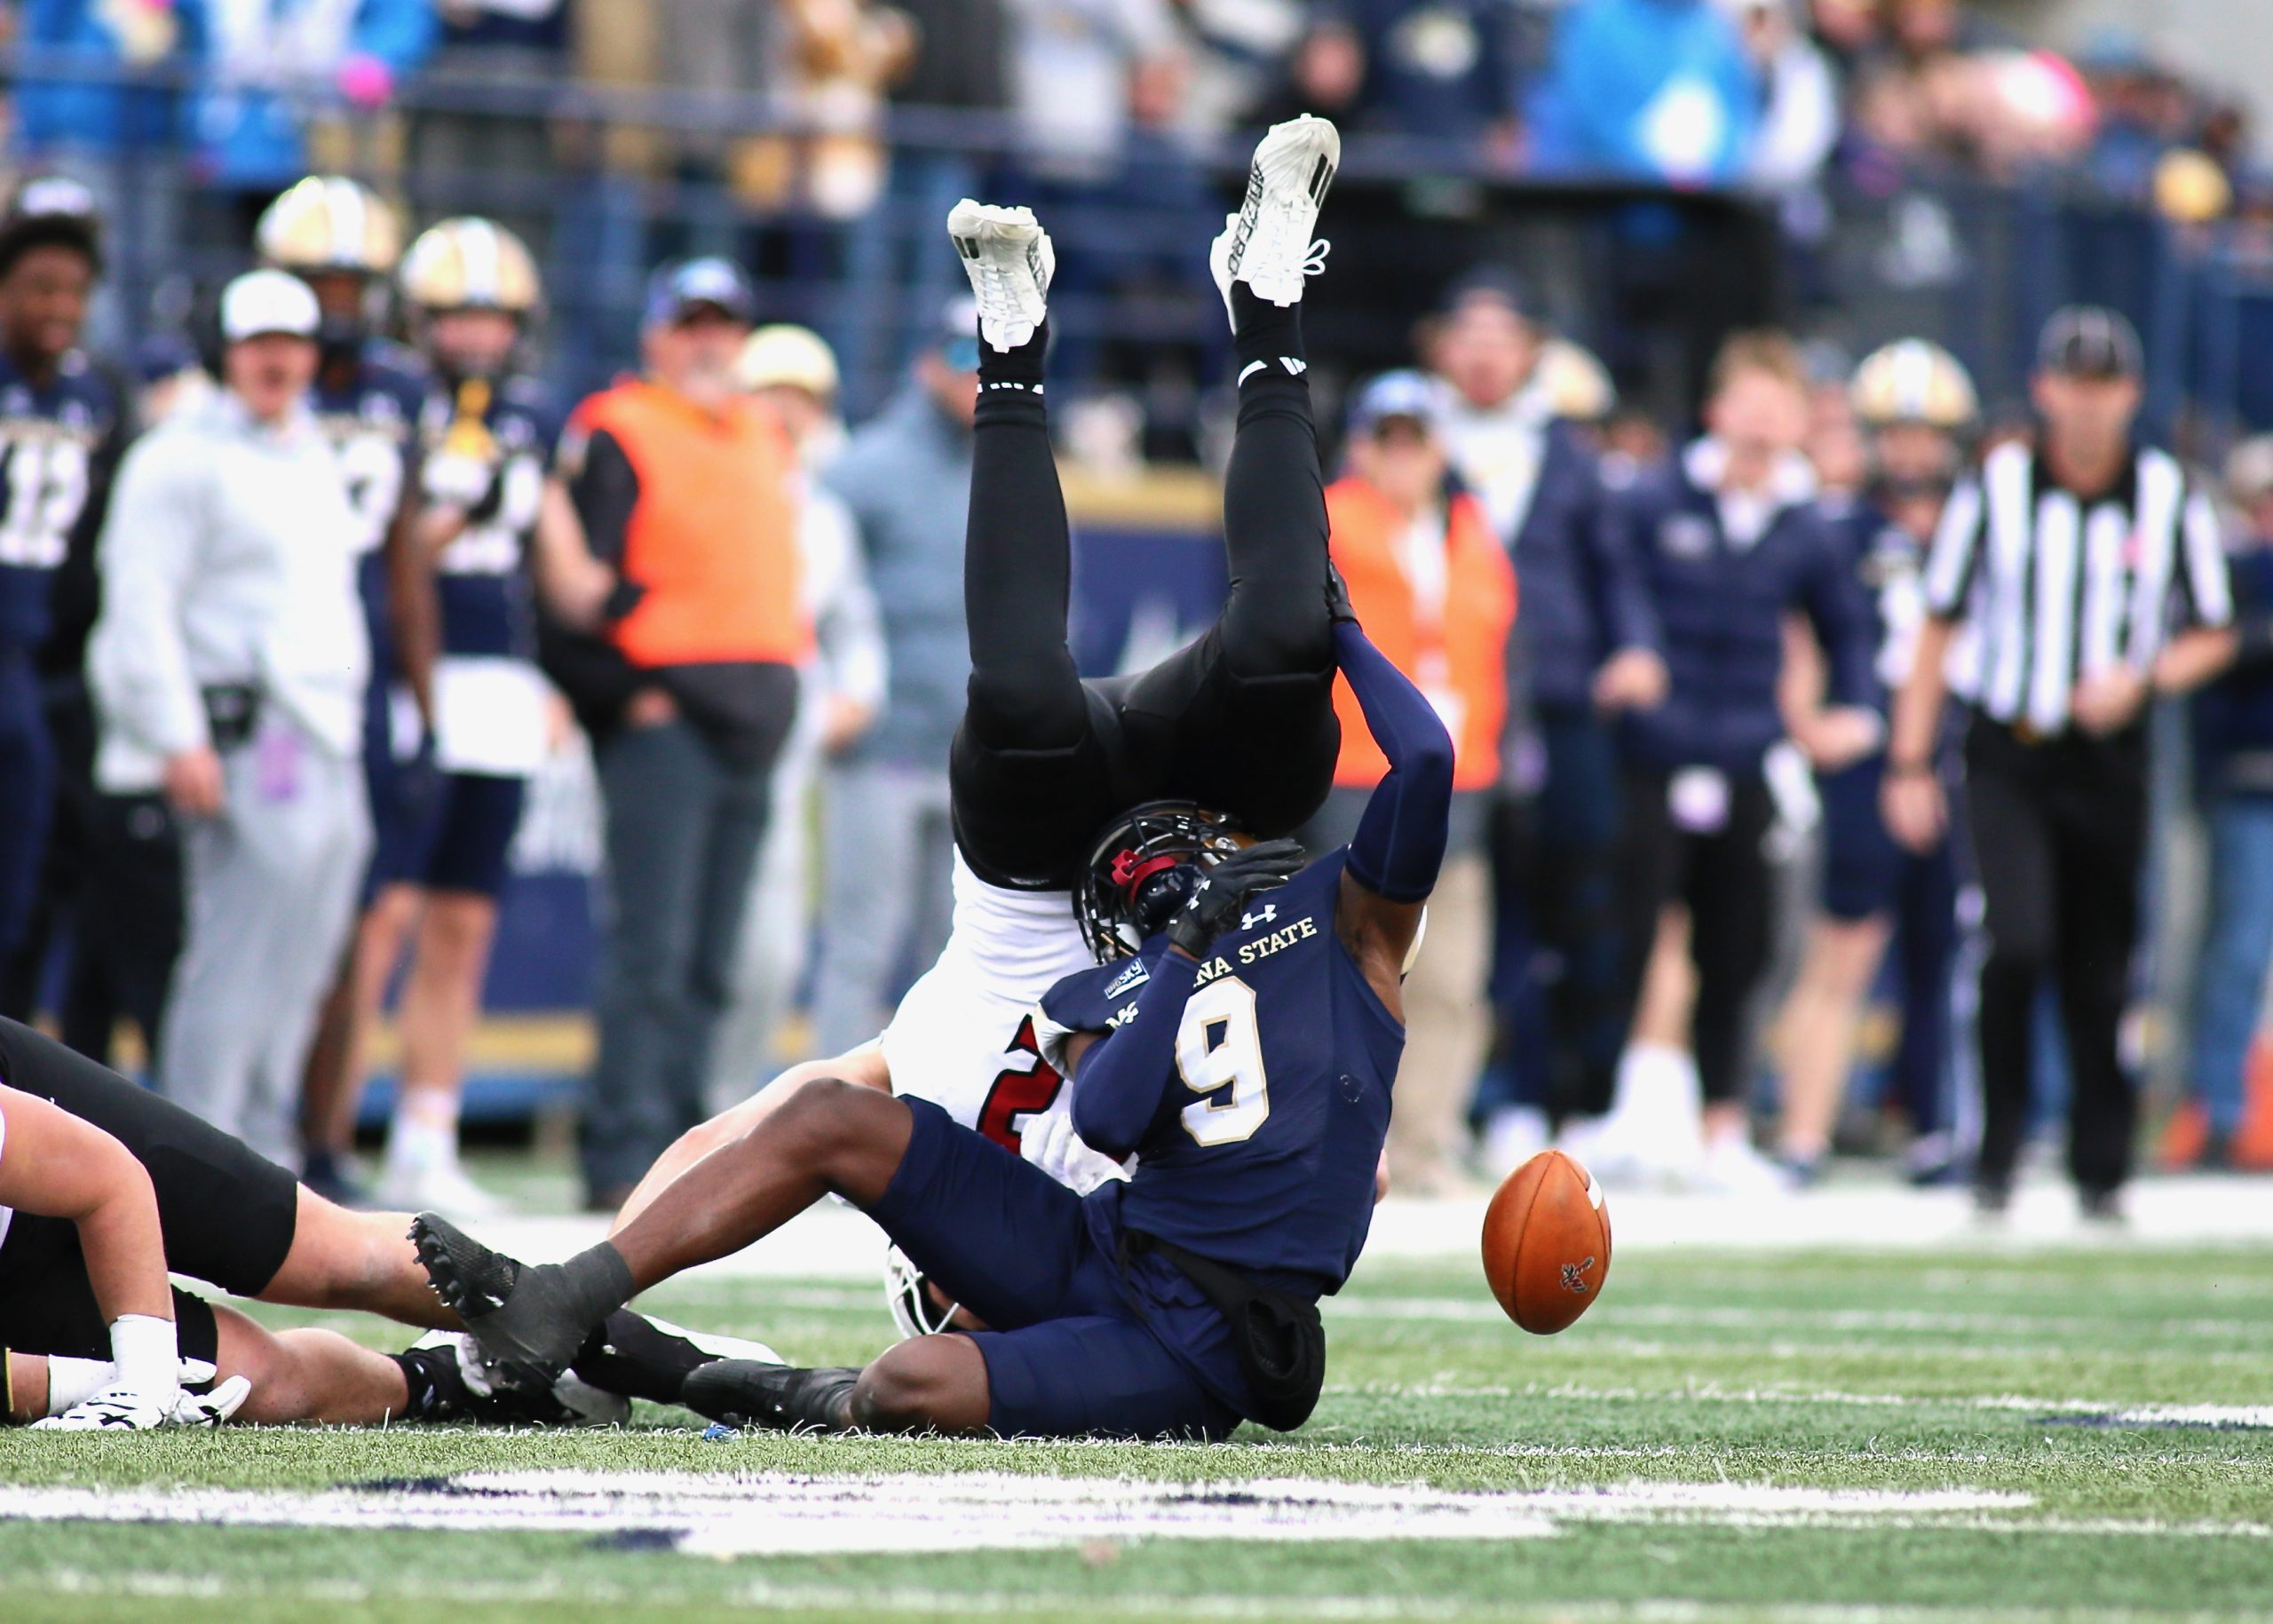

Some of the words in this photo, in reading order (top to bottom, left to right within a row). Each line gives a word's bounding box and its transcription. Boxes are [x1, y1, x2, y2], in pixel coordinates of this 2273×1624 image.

[1193, 956, 1233, 988] NA
[1238, 916, 1318, 964] STATE
[1176, 975, 1270, 1147] 9
